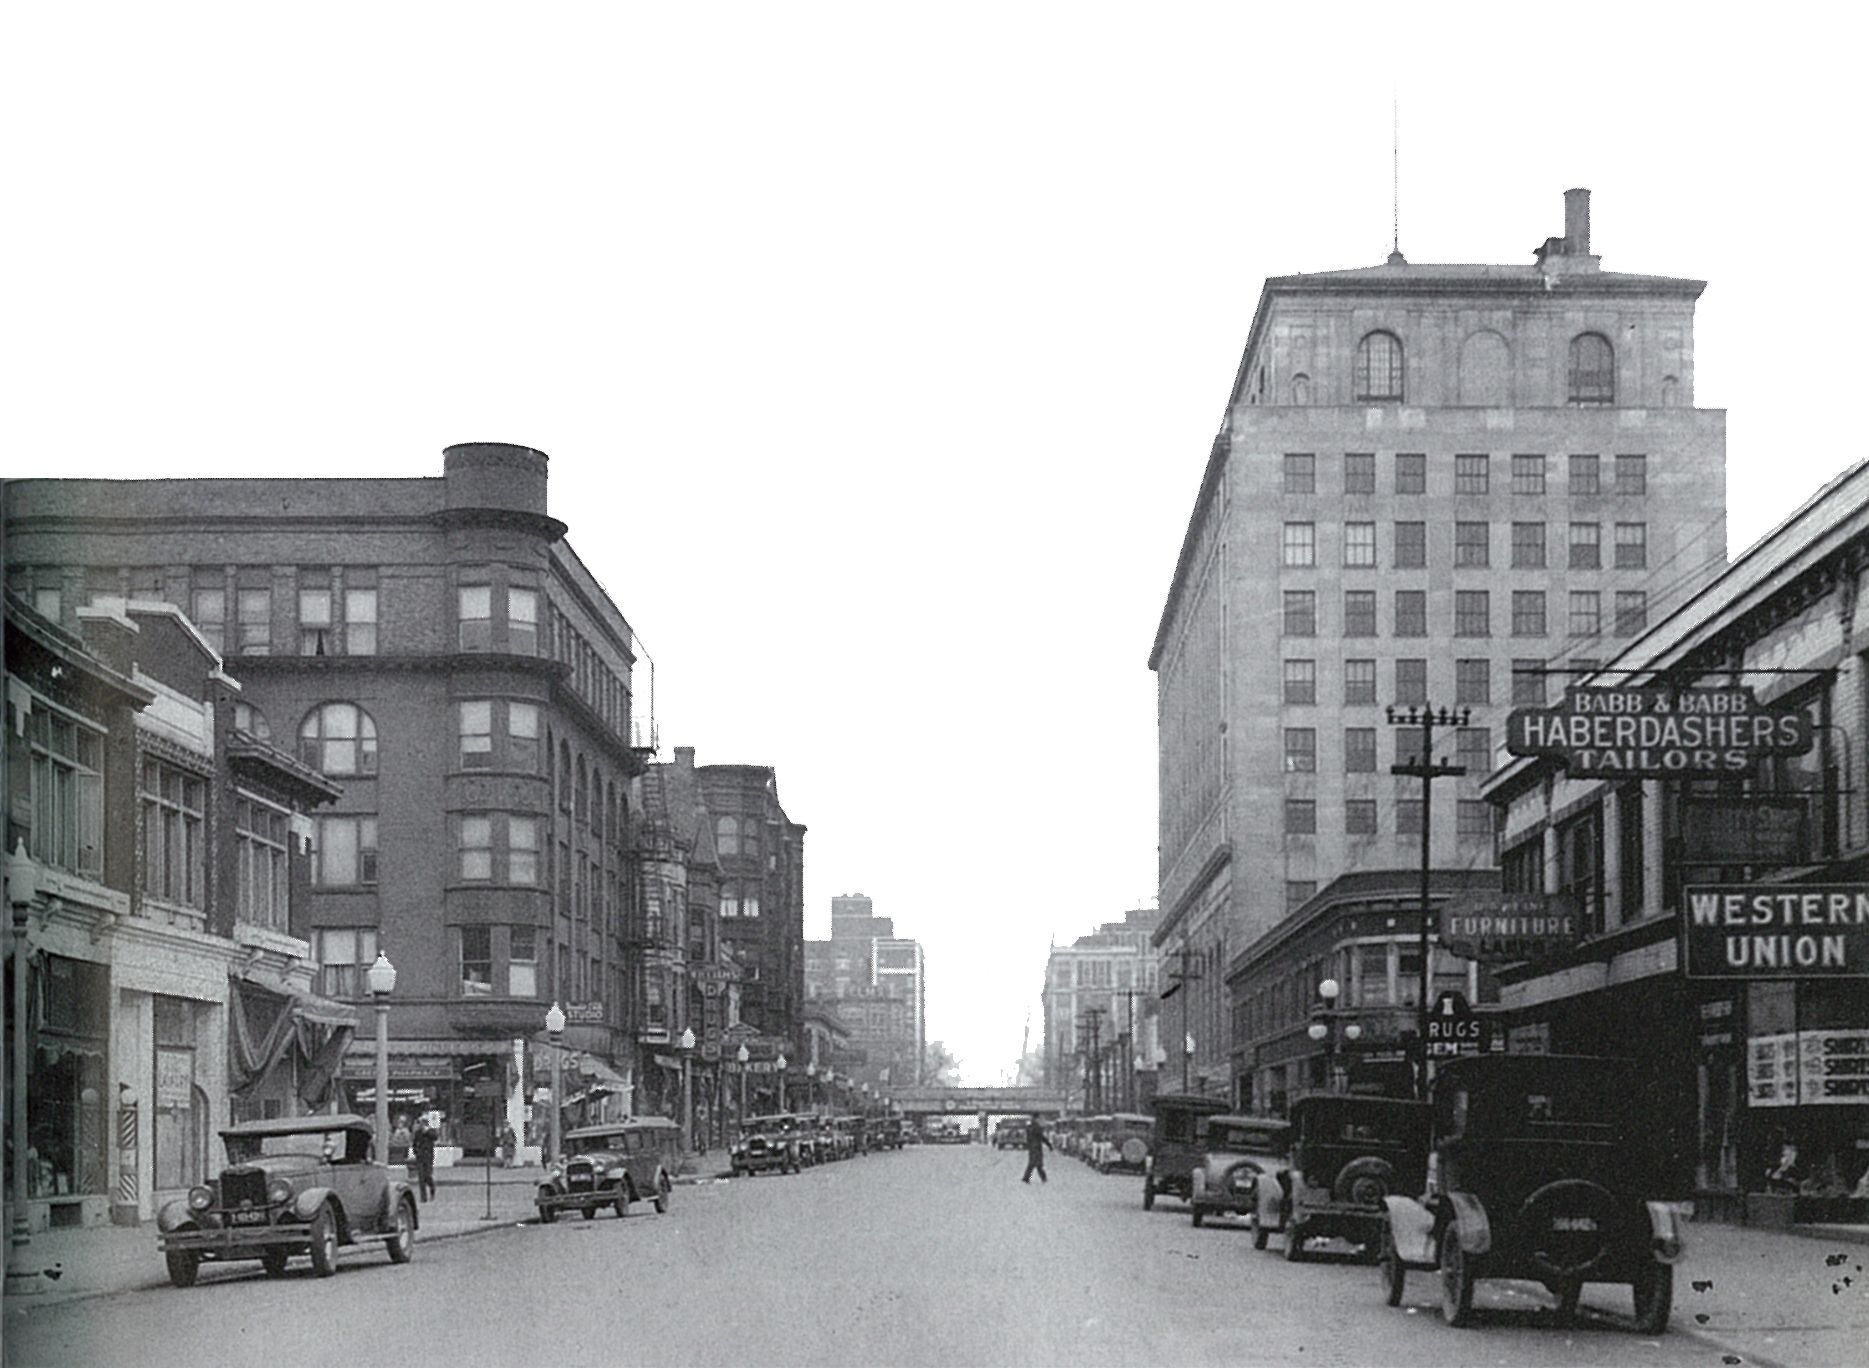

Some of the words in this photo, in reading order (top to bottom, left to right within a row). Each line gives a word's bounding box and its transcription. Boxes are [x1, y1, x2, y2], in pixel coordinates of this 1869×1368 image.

[1574, 692, 1642, 713] BABB
[1654, 692, 1671, 713] &
[1678, 692, 1747, 713] BABB
[1524, 716, 1800, 748] HABERDASHERS
[1574, 749, 1748, 770] TAILORS
[1450, 916, 1574, 936] FURNITURE
[1726, 934, 1846, 967] UNION
[567, 1010, 603, 1020] STUDIO
[532, 1051, 579, 1072] DRGS
